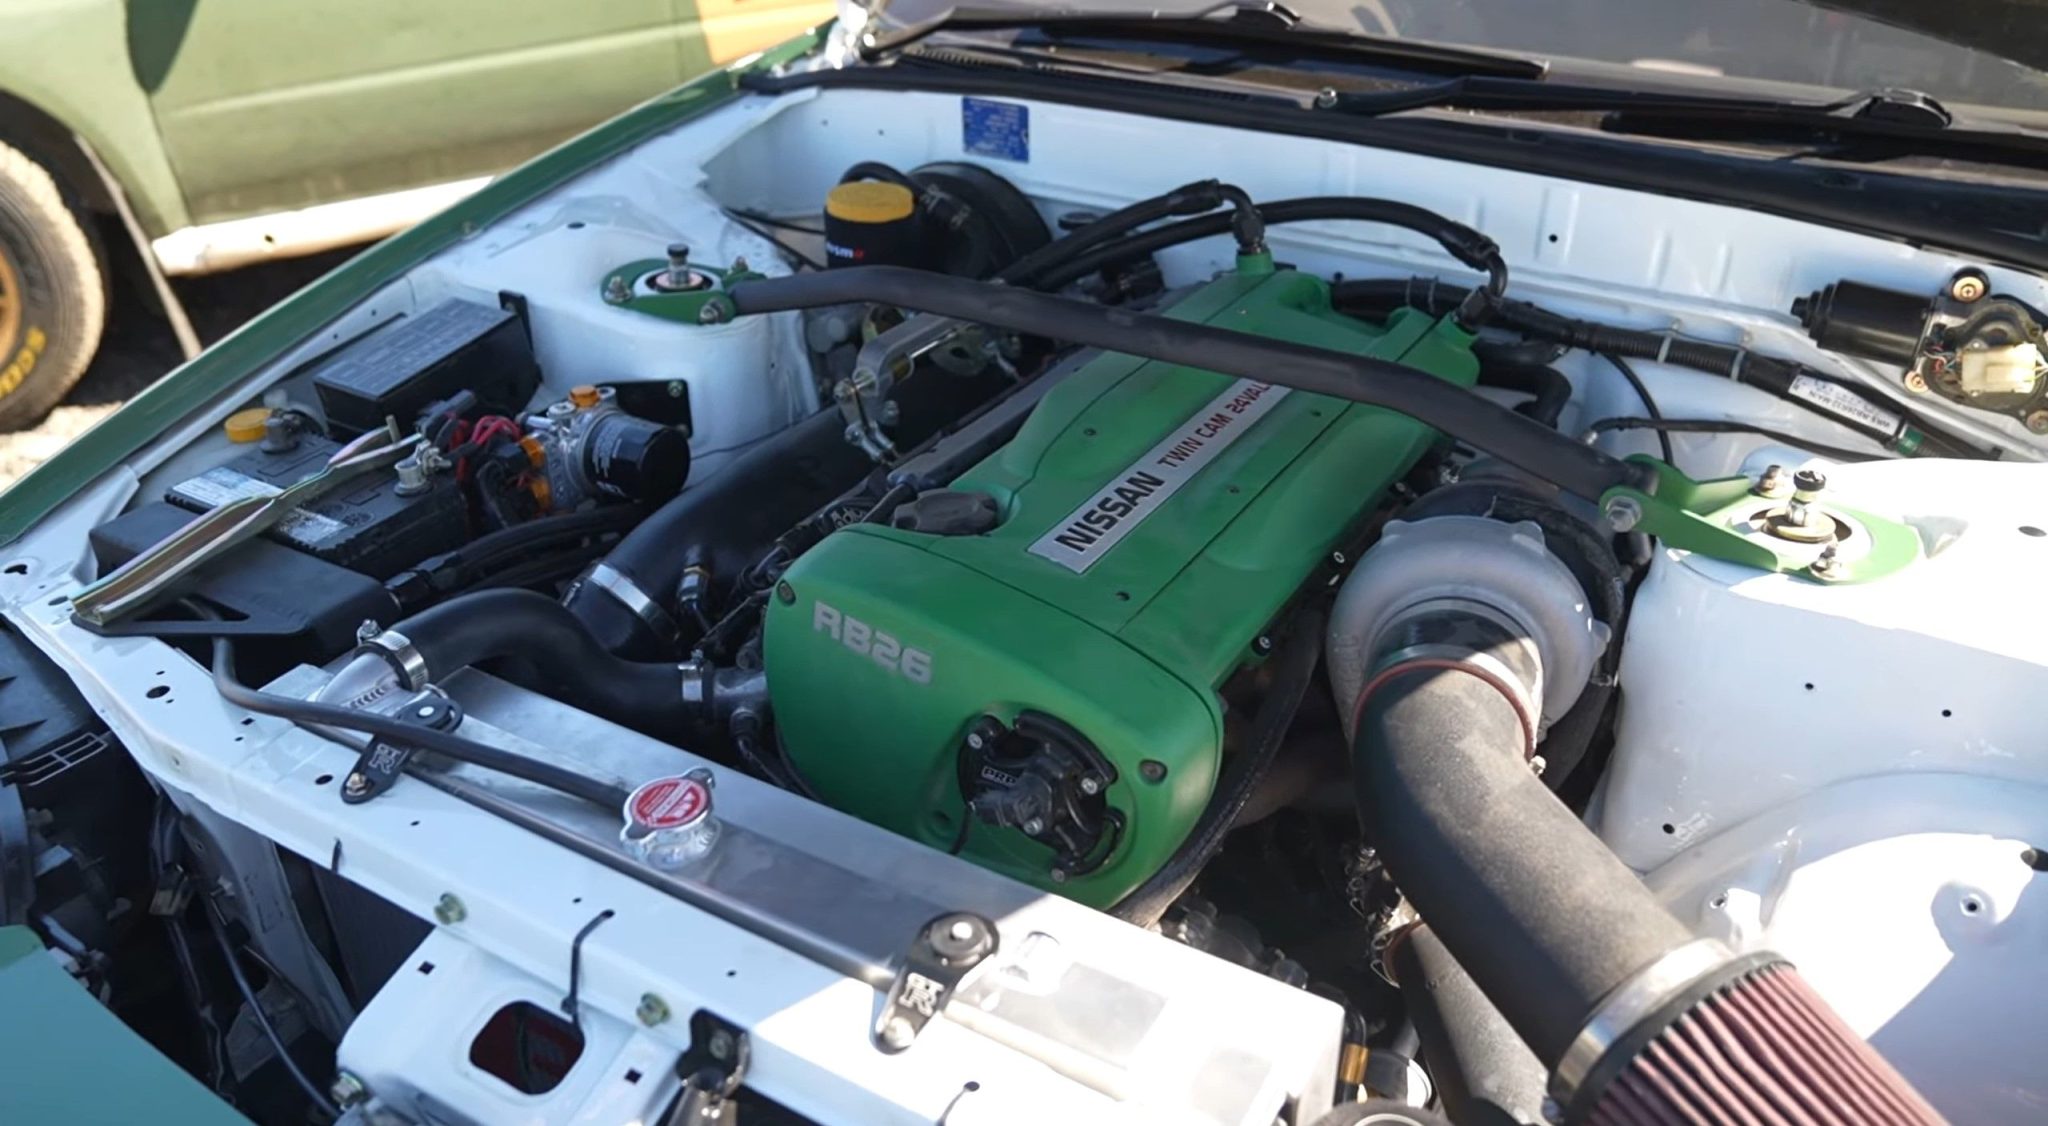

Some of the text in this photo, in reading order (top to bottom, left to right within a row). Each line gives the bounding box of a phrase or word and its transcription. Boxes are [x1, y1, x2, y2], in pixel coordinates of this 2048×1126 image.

[1055, 382, 1271, 552] NISSAN TWIN CAM 24VAL
[813, 600, 934, 684] RB26
